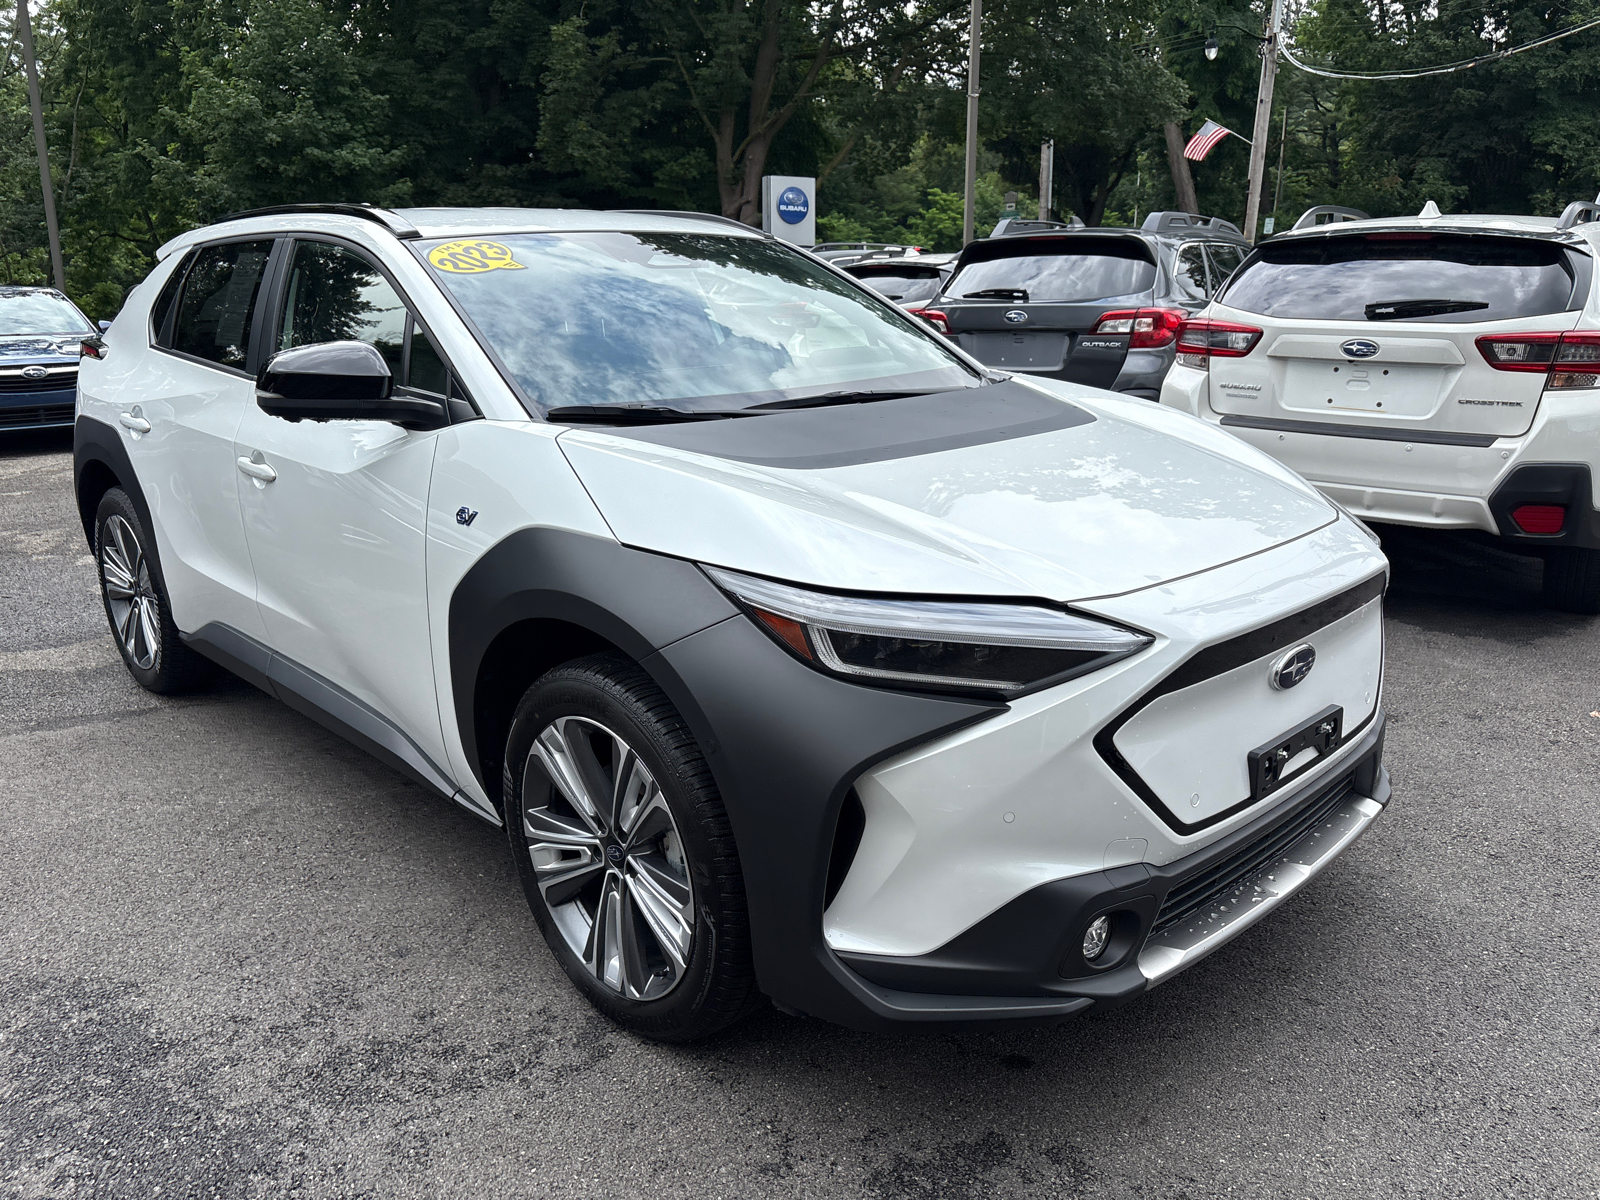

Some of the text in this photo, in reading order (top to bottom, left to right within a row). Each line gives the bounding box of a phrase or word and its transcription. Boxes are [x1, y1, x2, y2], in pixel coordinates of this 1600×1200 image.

[437, 242, 508, 271] 2023
[1219, 382, 1262, 392] SUBARU
[1458, 398, 1524, 408] CROSSTREK
